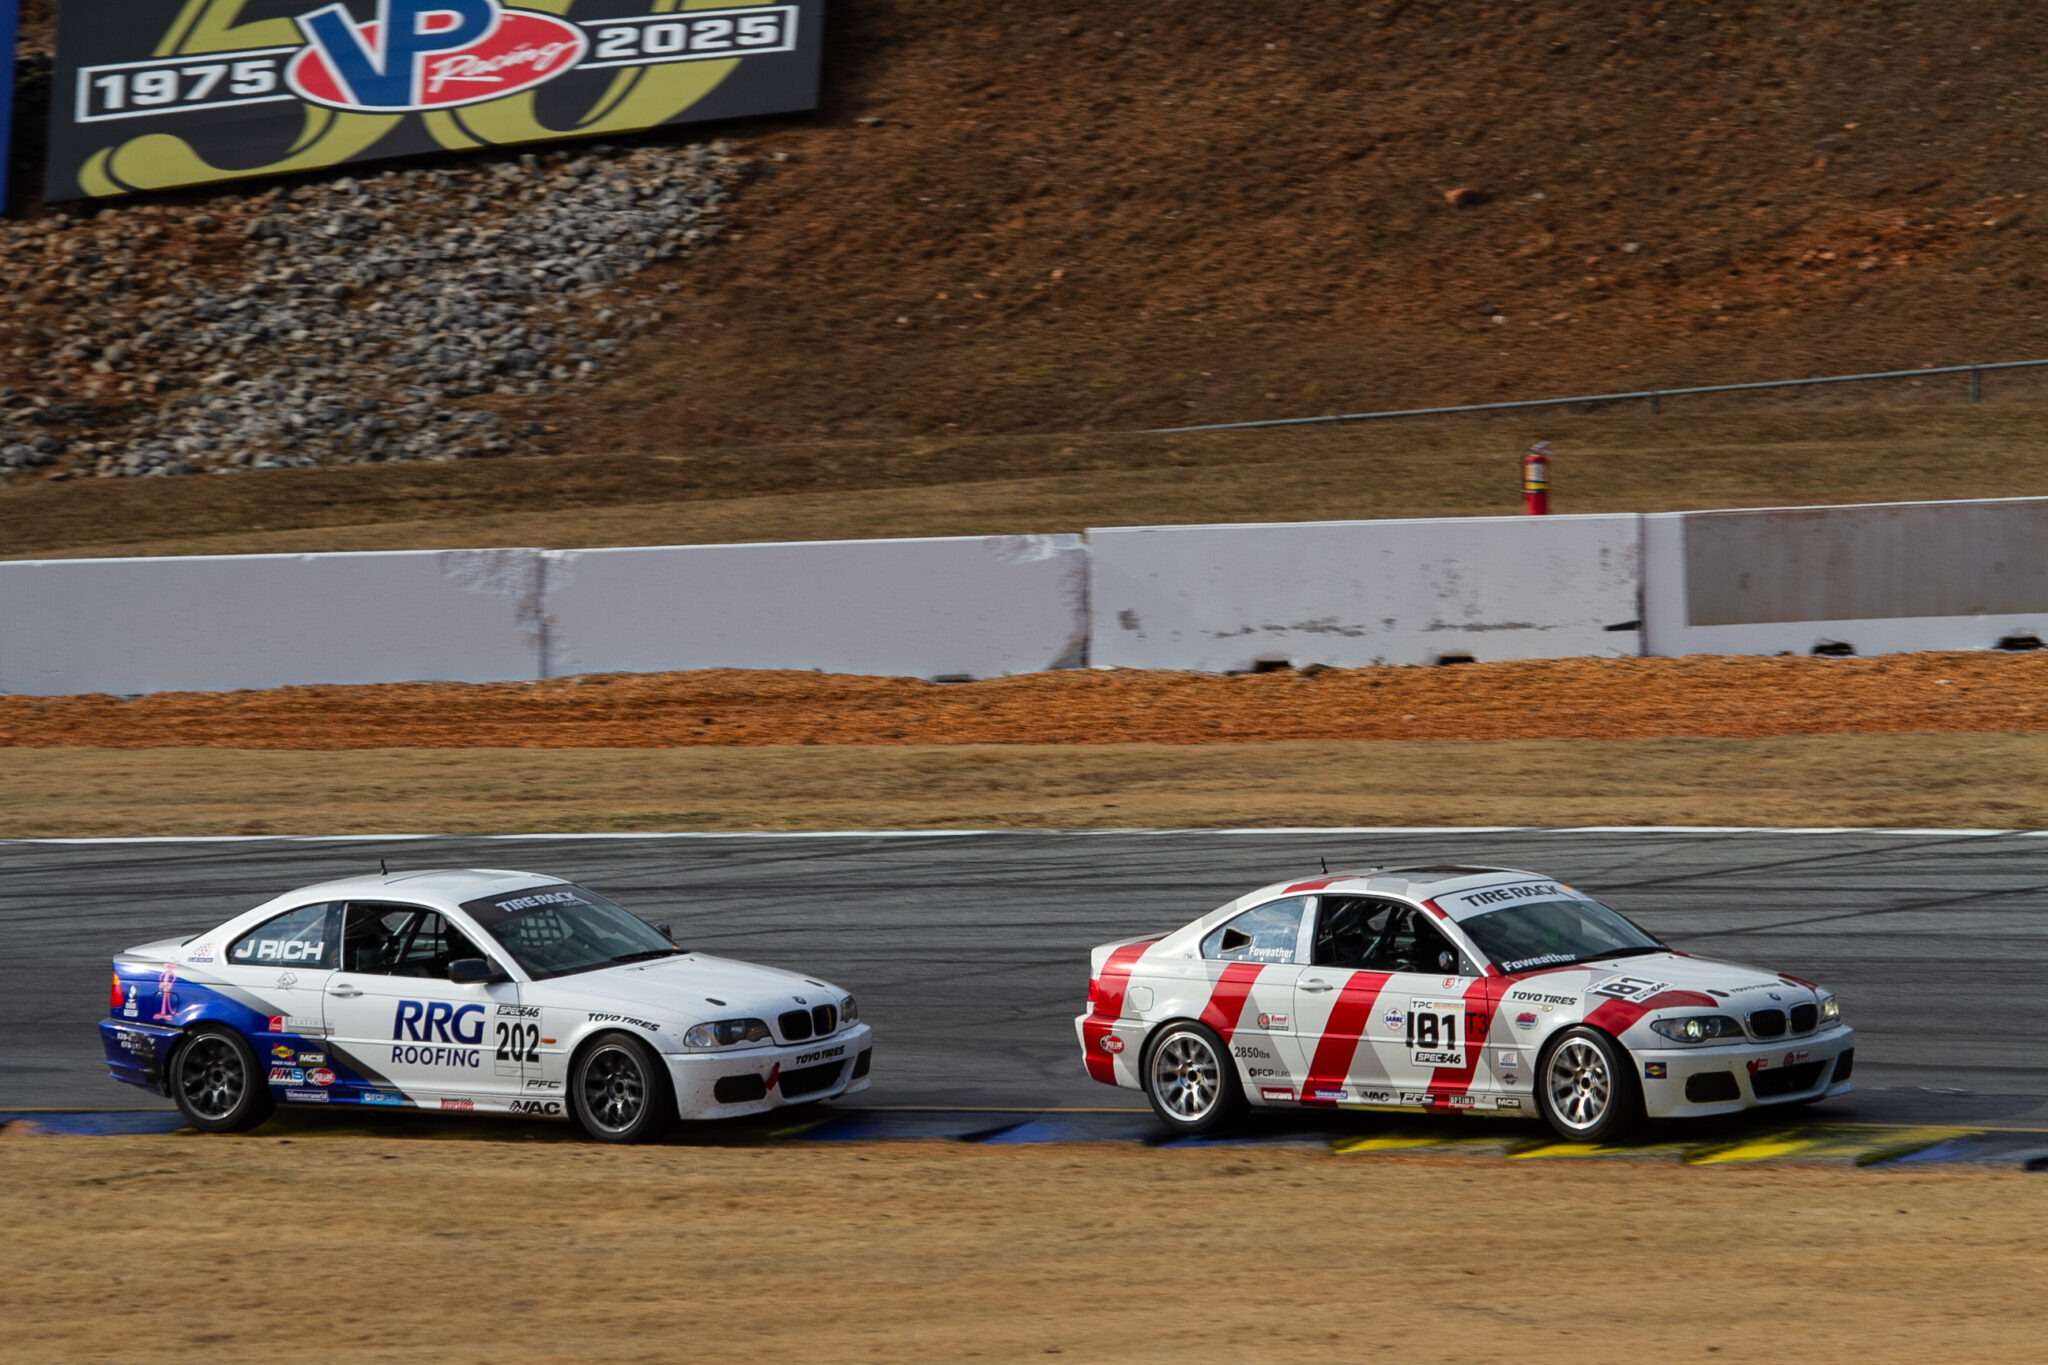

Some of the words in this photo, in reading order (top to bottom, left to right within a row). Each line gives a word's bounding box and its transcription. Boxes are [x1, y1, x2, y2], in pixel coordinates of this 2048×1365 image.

[595, 15, 780, 58] 2025
[295, 0, 500, 108] VP
[427, 39, 580, 94] Racing
[94, 60, 277, 109] 1975
[234, 939, 256, 959] J
[257, 940, 325, 961] RICH
[1248, 946, 1294, 959] Foweather
[1501, 954, 1577, 972] Foweather
[1412, 1001, 1433, 1009] TPC
[1512, 992, 1543, 1002] TOYO
[1543, 994, 1578, 1006] TIRES
[393, 1000, 486, 1044] RRG
[588, 1013, 622, 1022] TOYO
[621, 1016, 661, 1032] TIRES
[1406, 1011, 1456, 1050] 181
[1466, 1012, 1488, 1035] T3
[496, 1022, 540, 1063] 202
[300, 1054, 324, 1062] MCS
[391, 1046, 480, 1068] ROOFING
[796, 1052, 820, 1065] TOYO
[820, 1045, 845, 1059] TIRES
[269, 1068, 304, 1080] HMS
[1258, 1069, 1274, 1077] FCP
[527, 1080, 561, 1089] PFC
[1403, 1094, 1434, 1103] PFC
